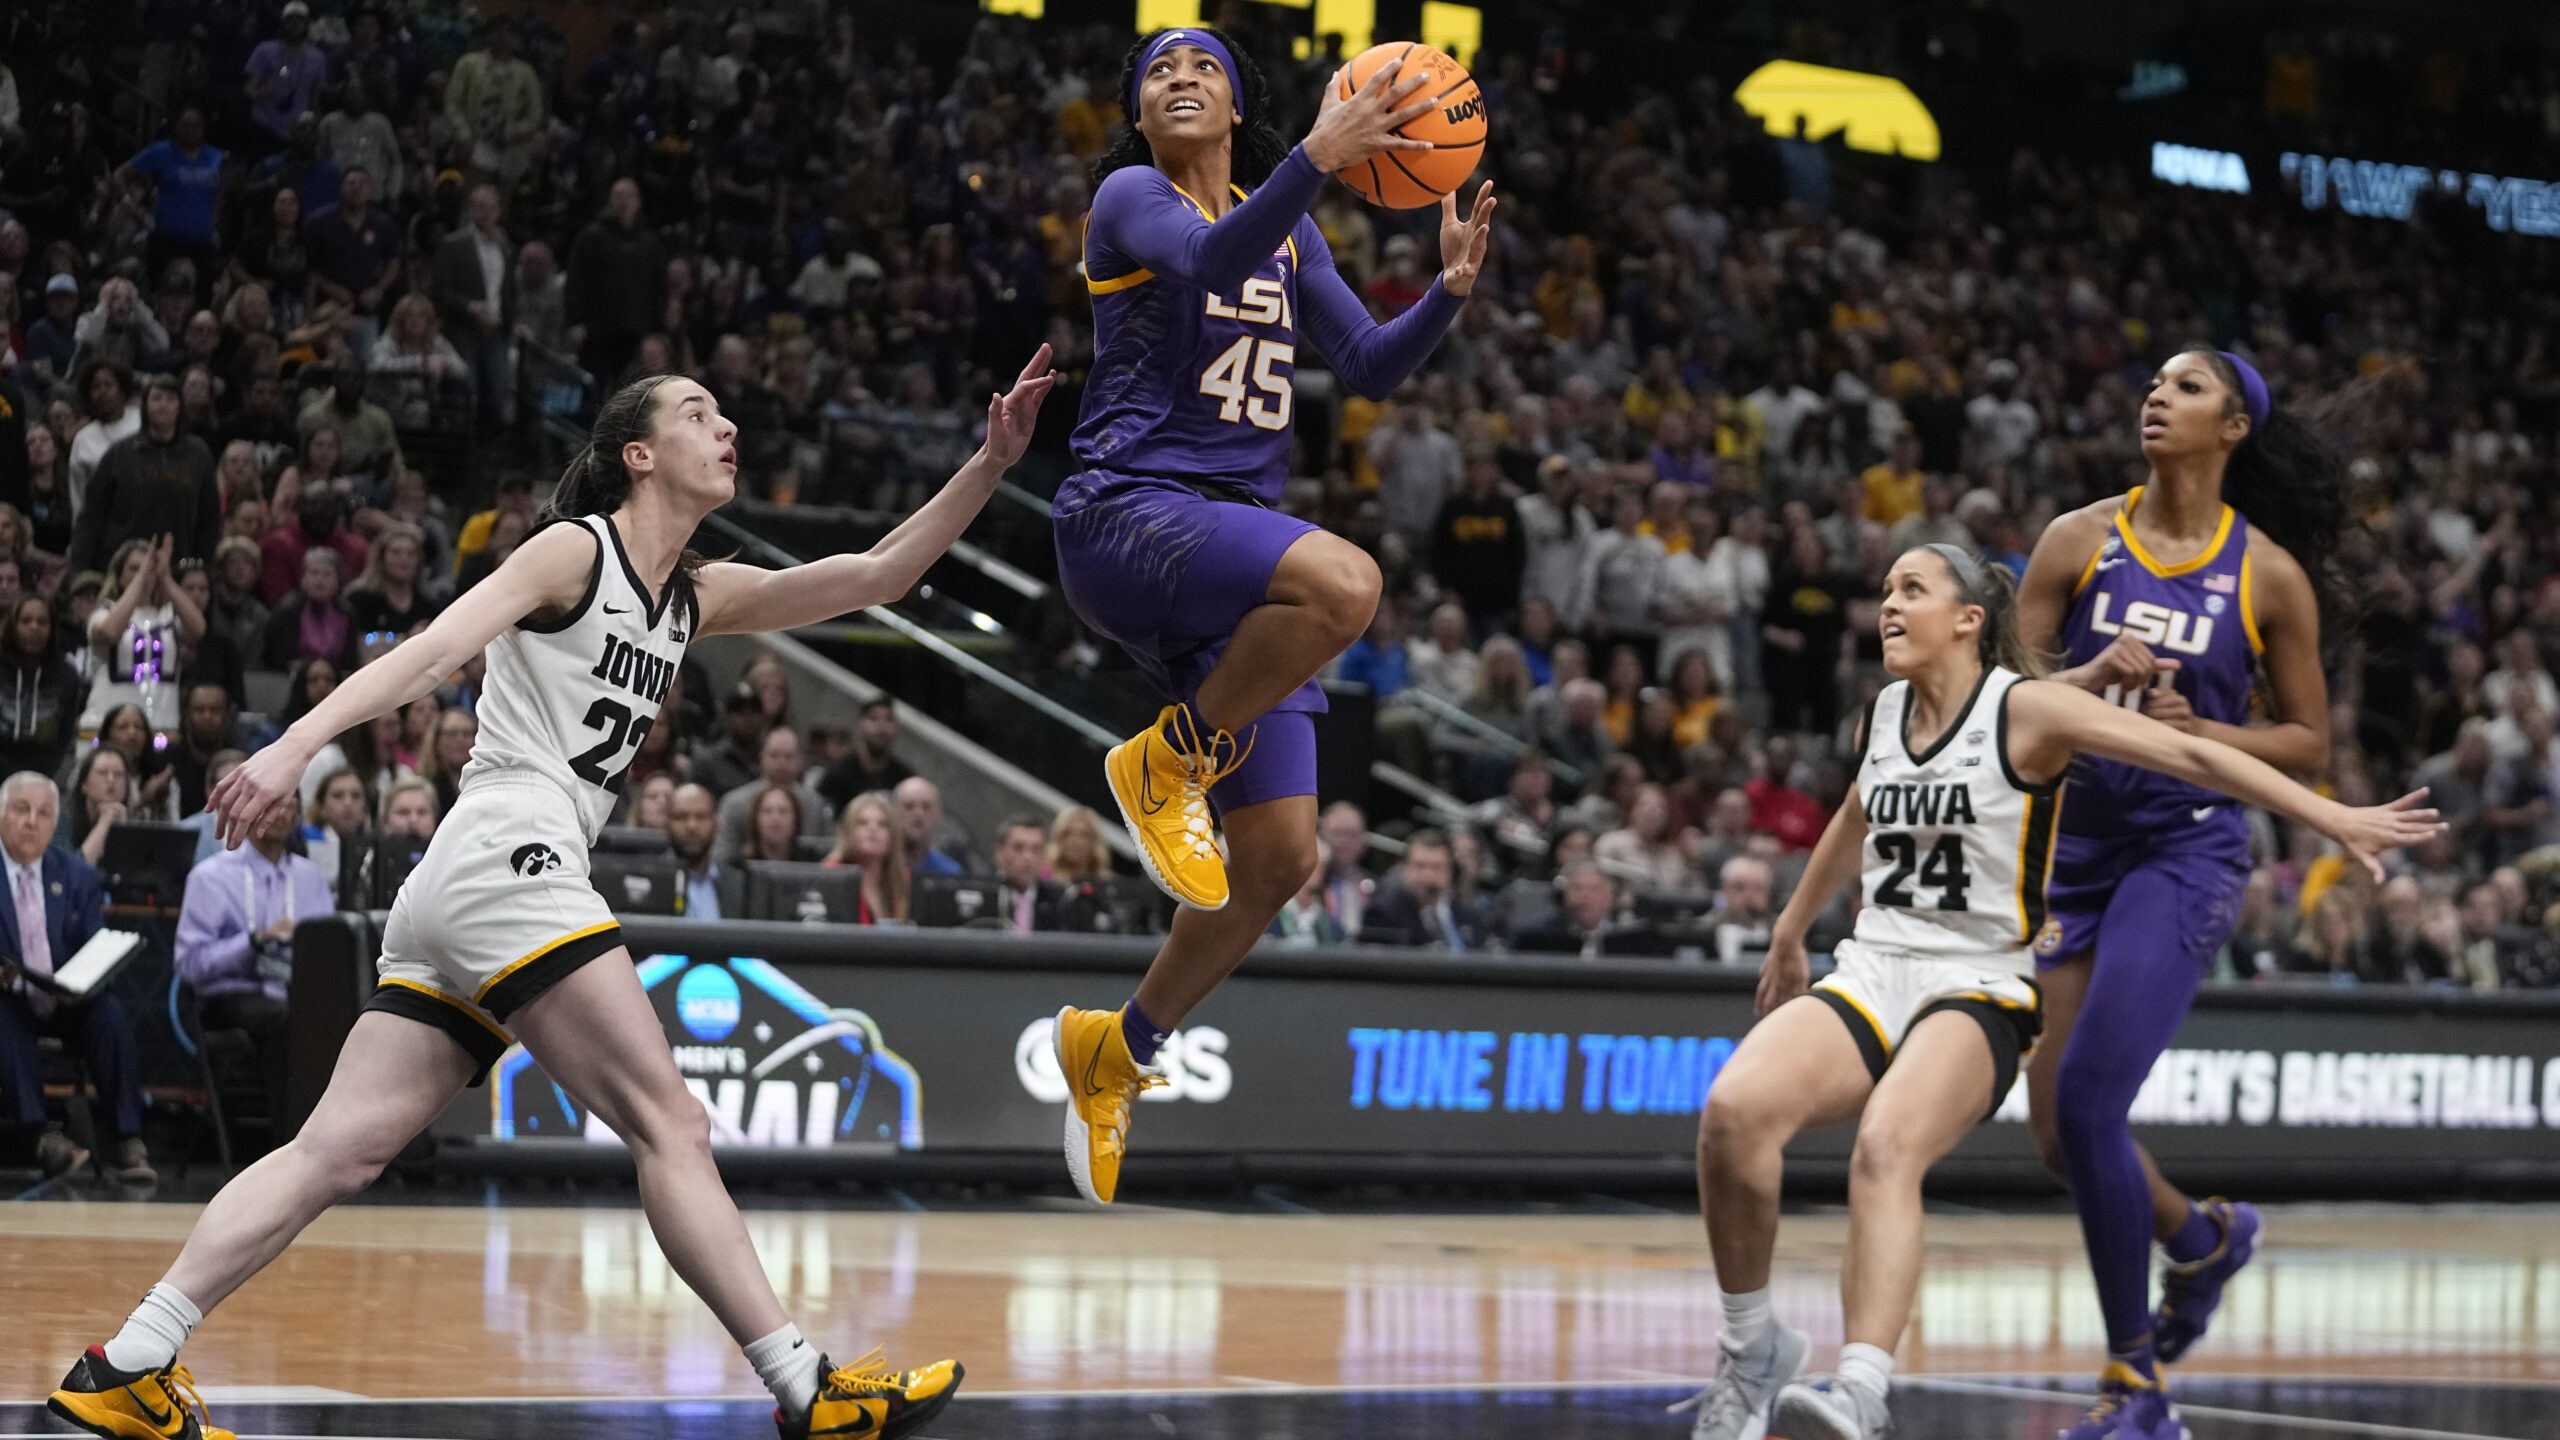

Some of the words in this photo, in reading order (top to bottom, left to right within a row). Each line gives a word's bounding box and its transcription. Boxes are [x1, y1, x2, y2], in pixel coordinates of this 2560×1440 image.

[1199, 335, 1294, 431] 45
[2091, 591, 2214, 656] LSU
[591, 632, 675, 705] IOWA
[1865, 783, 1976, 826] IOWA
[1873, 831, 1970, 912] 24
[672, 1046, 748, 1074] MEN'S
[1139, 1026, 1233, 1102] BS
[1347, 1027, 1498, 1111] TUNE
[1503, 1031, 1570, 1113] IN
[1577, 1034, 1742, 1114] TOMO
[2127, 1048, 2276, 1126] MEN'S
[2279, 1050, 2539, 1129] BASKETBALL
